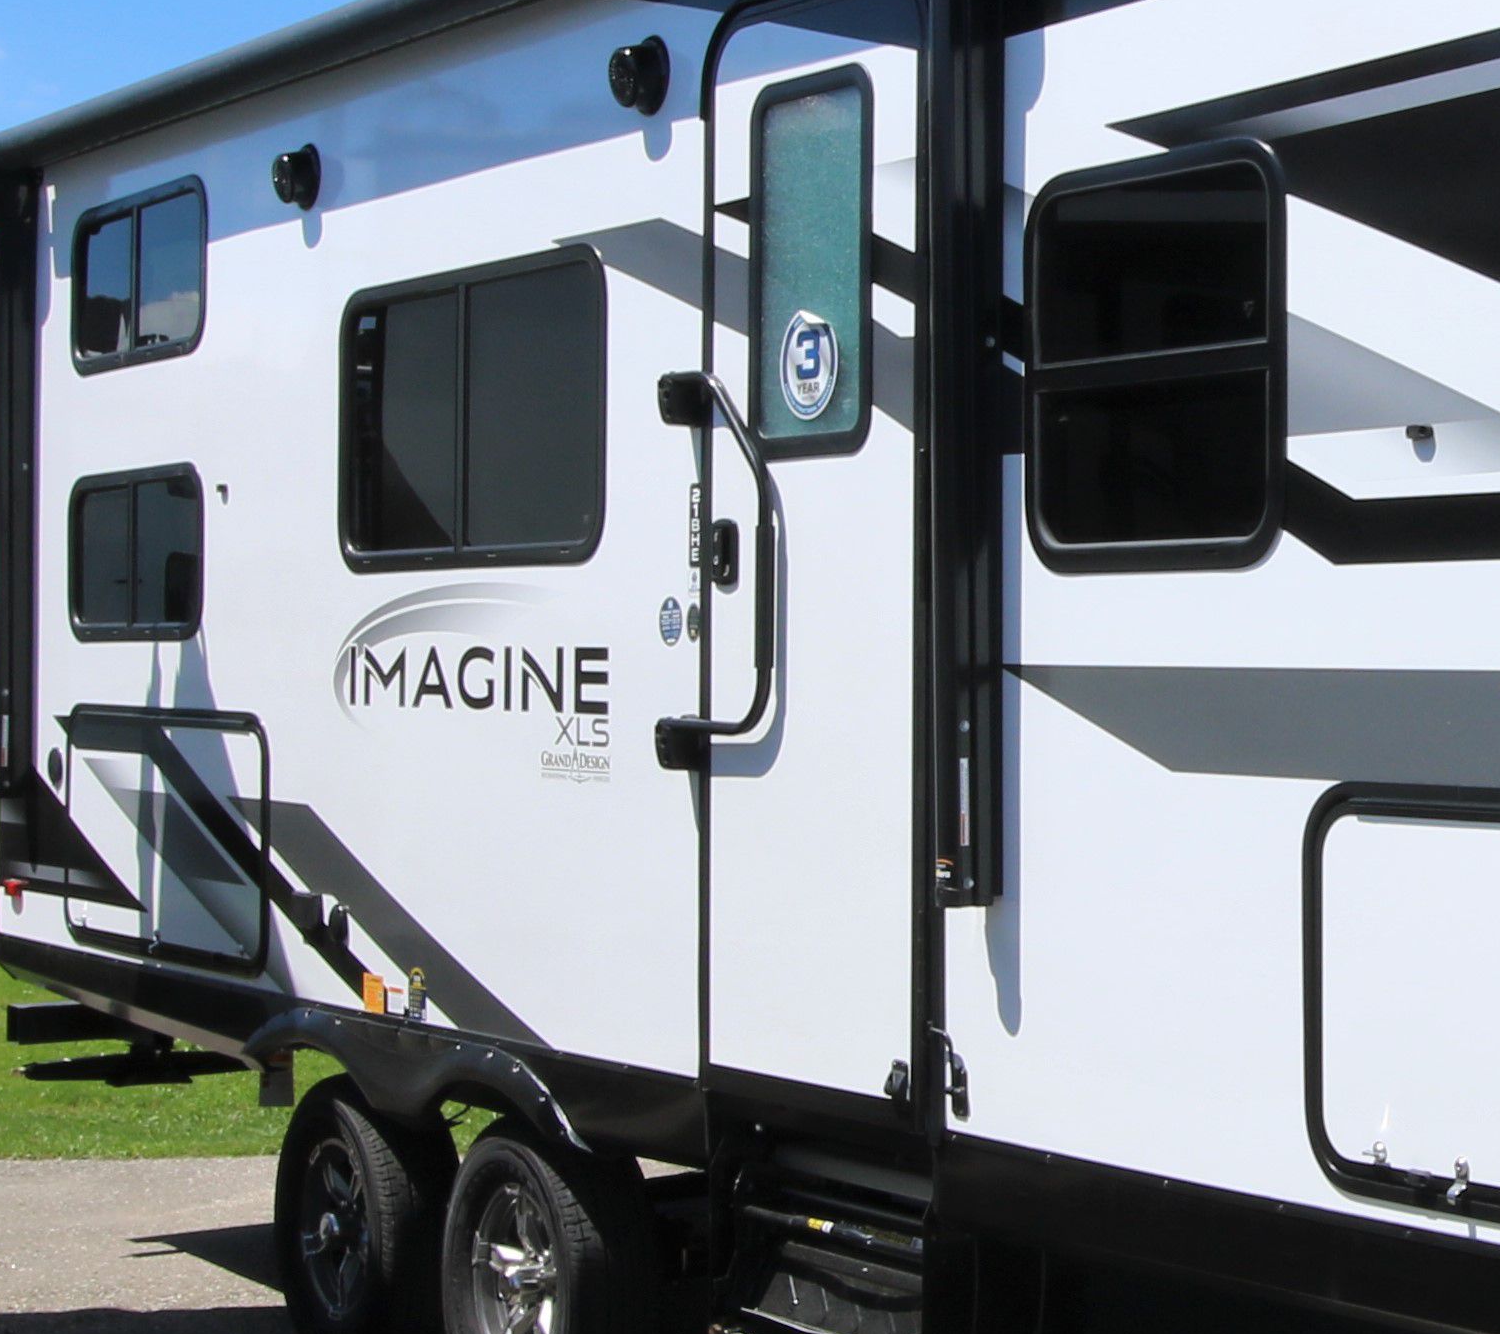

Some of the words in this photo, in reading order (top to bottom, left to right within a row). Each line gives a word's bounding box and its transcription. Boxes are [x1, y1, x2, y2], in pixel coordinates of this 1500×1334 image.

[796, 329, 820, 379] 3
[796, 381, 820, 395] YEAR
[349, 646, 609, 715] IMAGINE
[554, 716, 610, 747] XLS
[541, 750, 571, 768] GRAND
[579, 752, 610, 769] DESIGN
